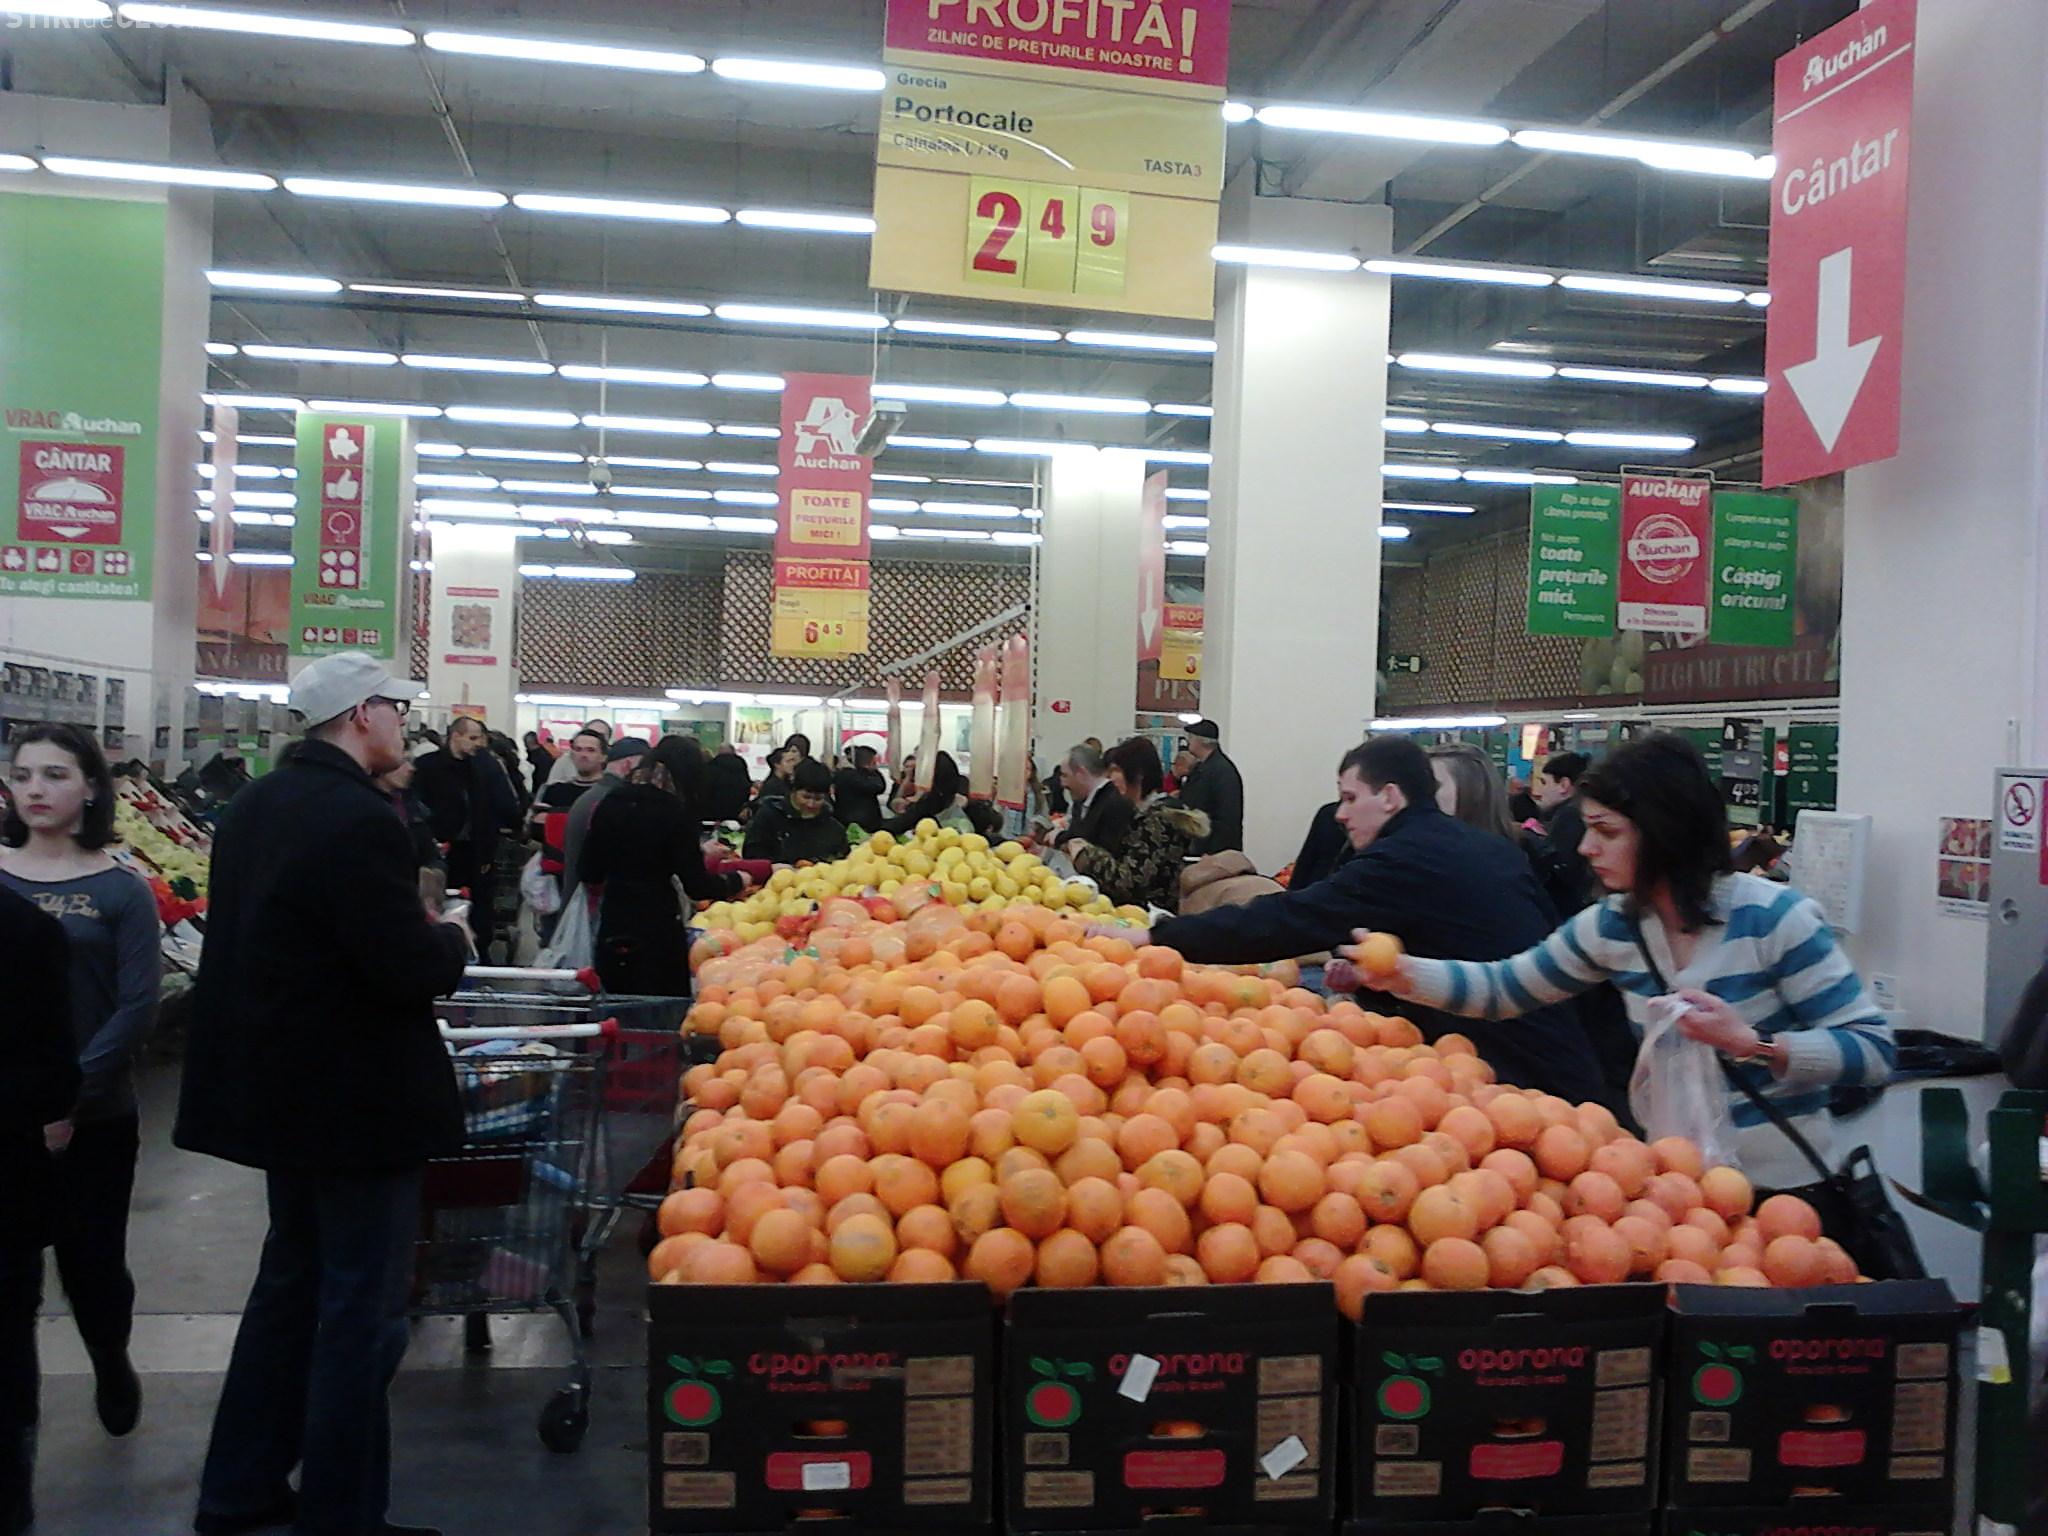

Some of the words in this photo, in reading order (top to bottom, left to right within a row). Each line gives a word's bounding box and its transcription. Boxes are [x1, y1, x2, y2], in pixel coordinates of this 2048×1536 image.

[927, 28, 978, 47] ZILNIC
[982, 35, 1004, 51] DE
[1099, 49, 1173, 72] NOASTRE
[1803, 25, 1887, 92] Auchan
[897, 73, 948, 90] Grecia
[894, 96, 1034, 134] Portocale
[1781, 128, 1899, 215] Cântar
[5, 409, 61, 429] VRAC
[62, 411, 142, 434] Auchan
[35, 446, 112, 474] CÂNTAR
[793, 454, 861, 471] Auchan
[1629, 480, 1702, 500] AUCHAN
[802, 495, 850, 509] TOATE
[1540, 546, 1584, 563] toate
[1636, 542, 1691, 557] Auchan
